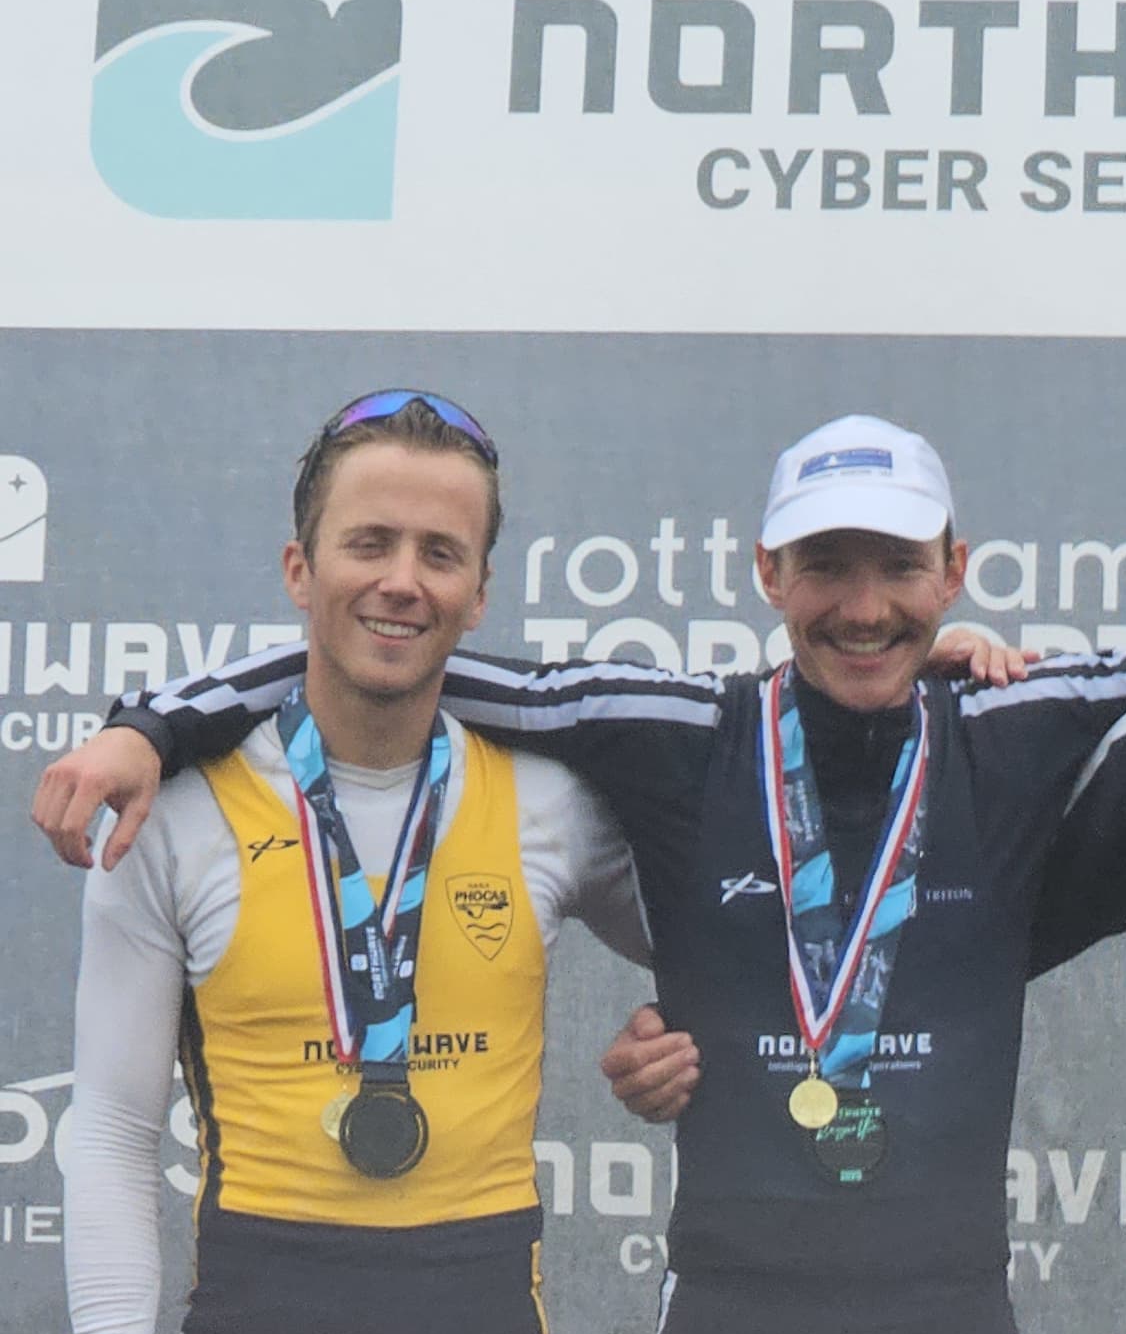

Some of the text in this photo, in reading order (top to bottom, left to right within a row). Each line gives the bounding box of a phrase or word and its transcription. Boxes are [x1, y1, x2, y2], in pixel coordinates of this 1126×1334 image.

[696, 148, 988, 211] CYBER
[455, 890, 507, 902] PHOCAS
[304, 1032, 489, 1061] NWAVE
[758, 1033, 932, 1057] NOAVE
[408, 1058, 460, 1071] CURITY
